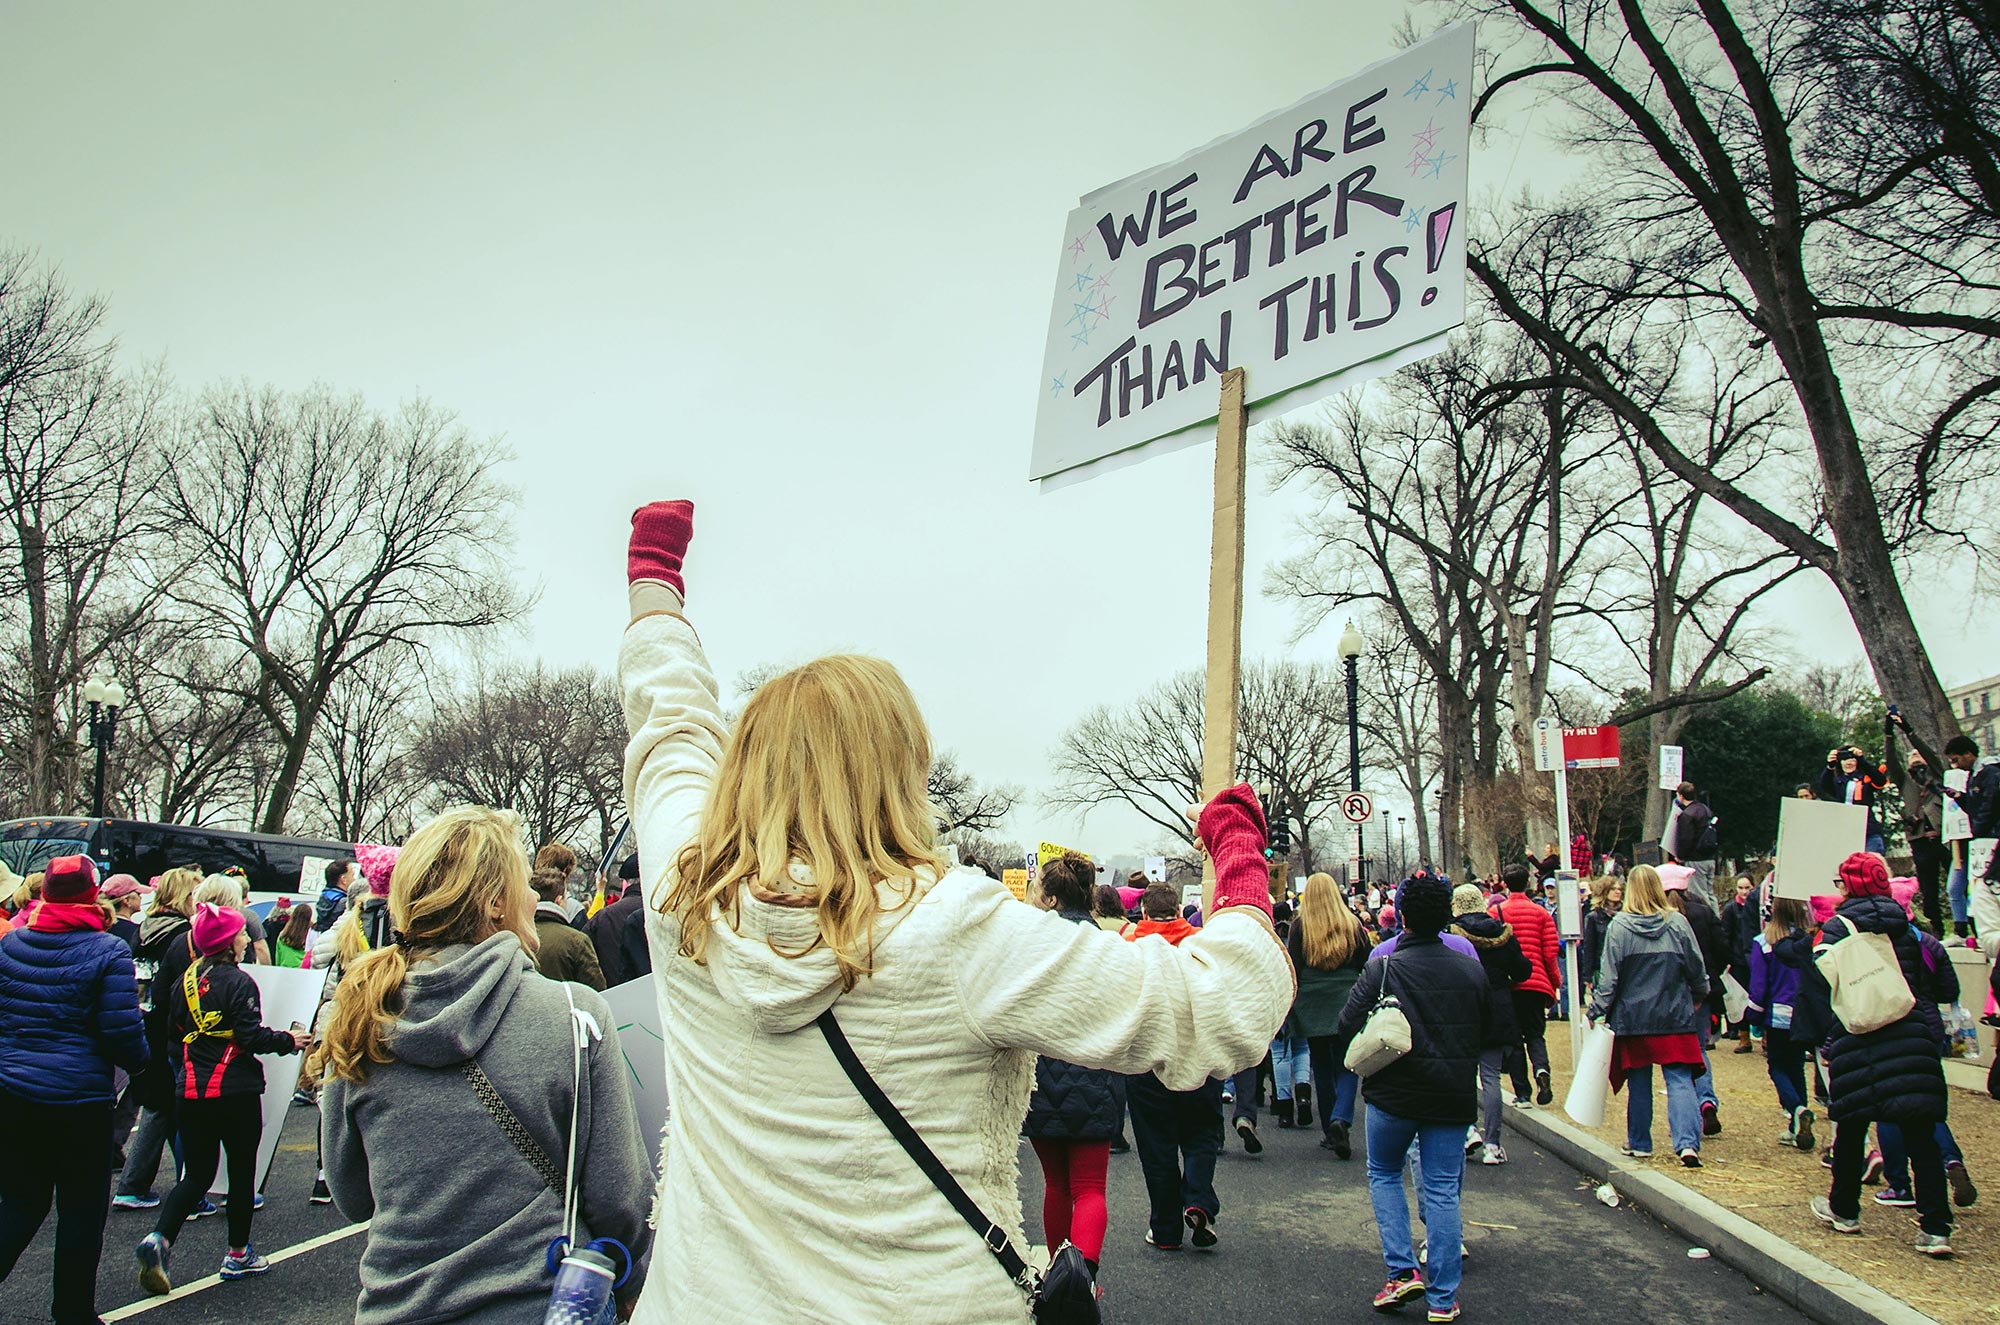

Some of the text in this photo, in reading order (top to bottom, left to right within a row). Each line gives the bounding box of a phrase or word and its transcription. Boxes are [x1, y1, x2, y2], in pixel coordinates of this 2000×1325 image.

[1096, 88, 1388, 261] WE ARE
[1138, 165, 1405, 329] BETTER
[1074, 309, 1232, 428] THAN
[1540, 731, 1549, 769] metrobus
